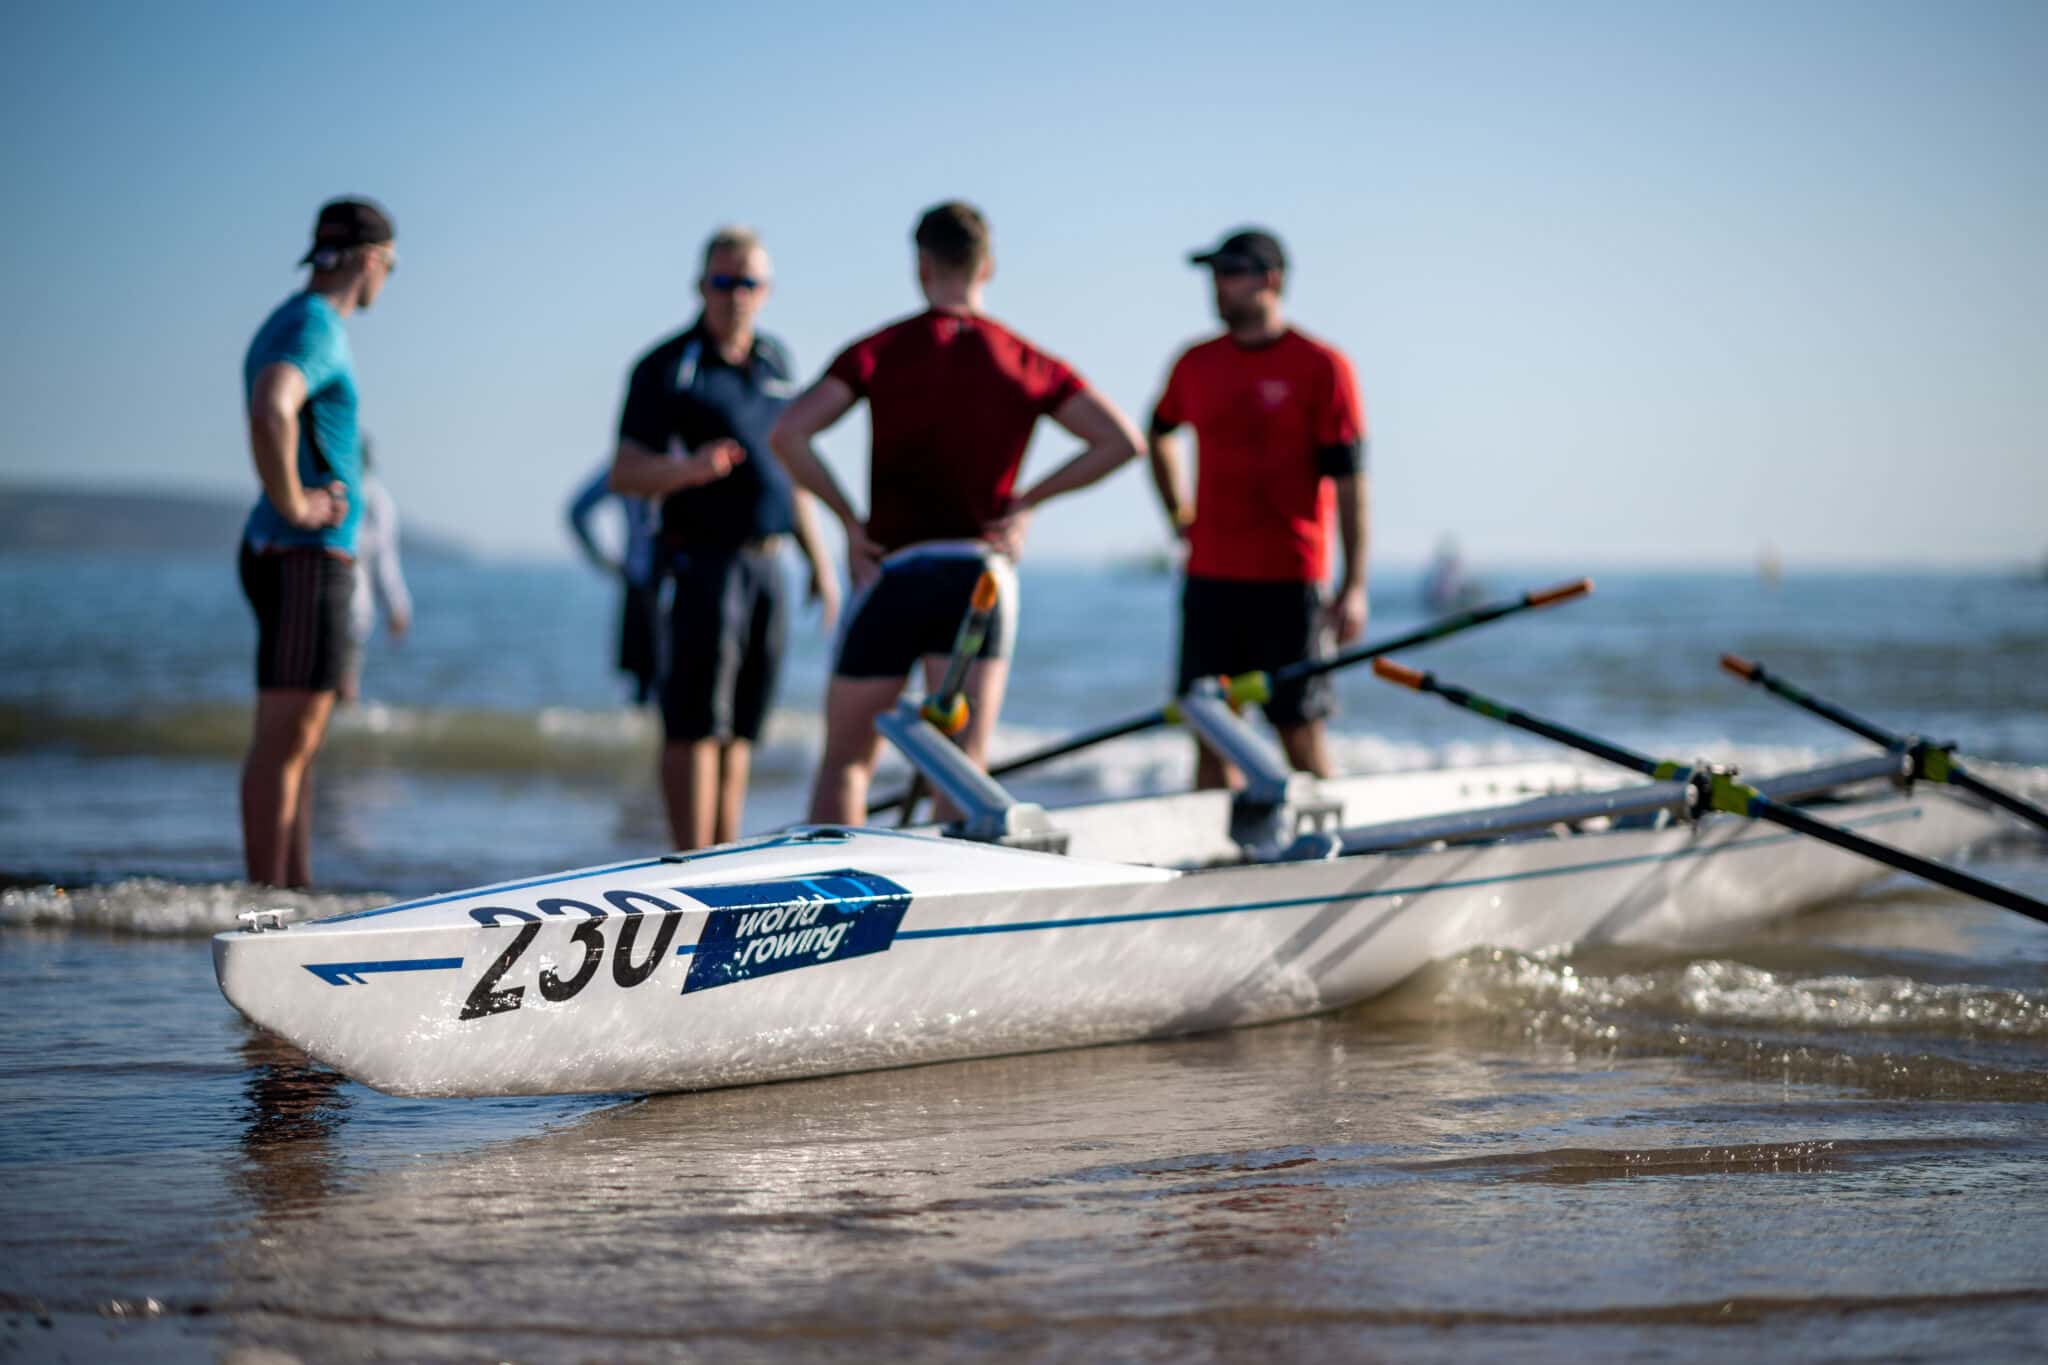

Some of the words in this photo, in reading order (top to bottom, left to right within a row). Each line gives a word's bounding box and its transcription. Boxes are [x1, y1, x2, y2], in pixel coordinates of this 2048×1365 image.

[735, 893, 825, 939] world
[458, 890, 684, 1021] 230
[739, 920, 849, 967] rowing
